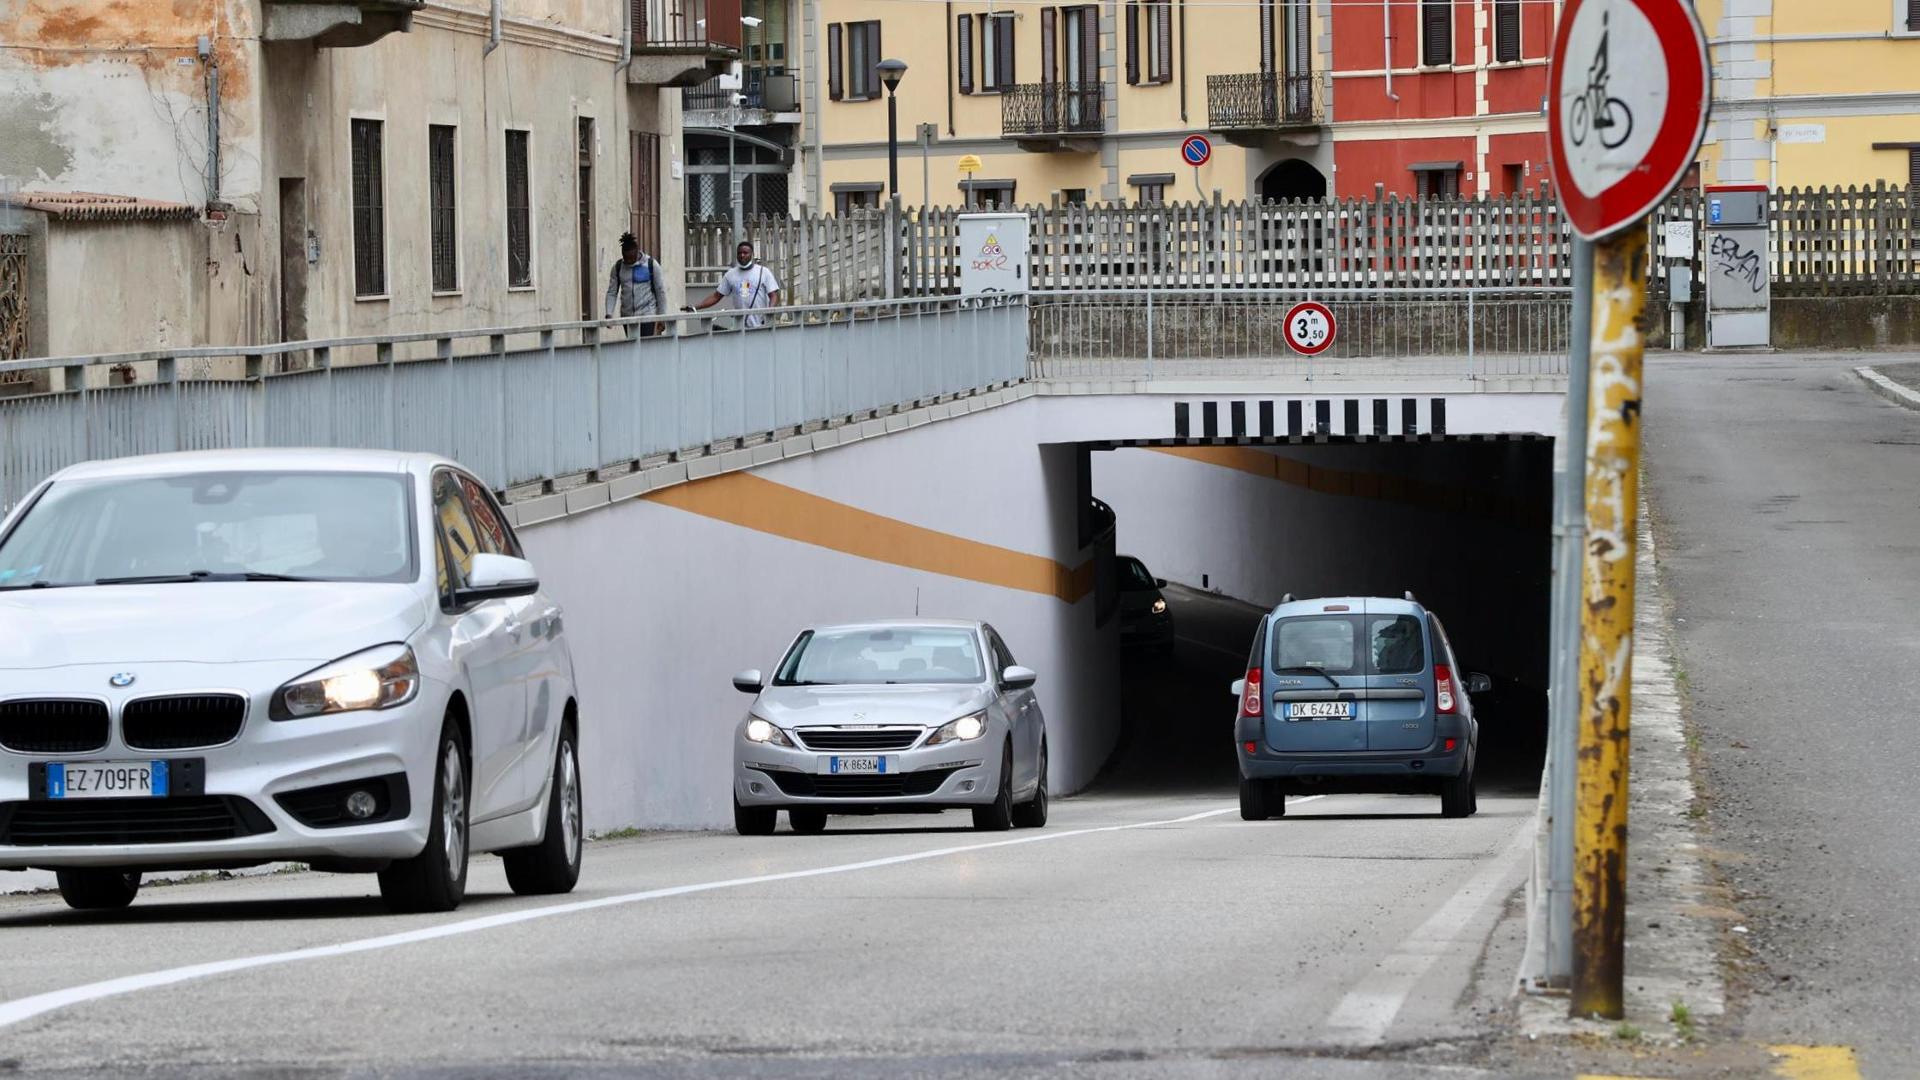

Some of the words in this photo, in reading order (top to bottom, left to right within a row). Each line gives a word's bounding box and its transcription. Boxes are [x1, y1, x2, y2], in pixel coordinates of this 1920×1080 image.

[1297, 318, 1309, 339] 3
[1292, 703, 1306, 716] DK
[1310, 703, 1348, 716] 642AX
[838, 759, 849, 770] FK
[851, 758, 878, 770] 863AW
[66, 769, 87, 791] EZ
[94, 768, 151, 791] 709FR
